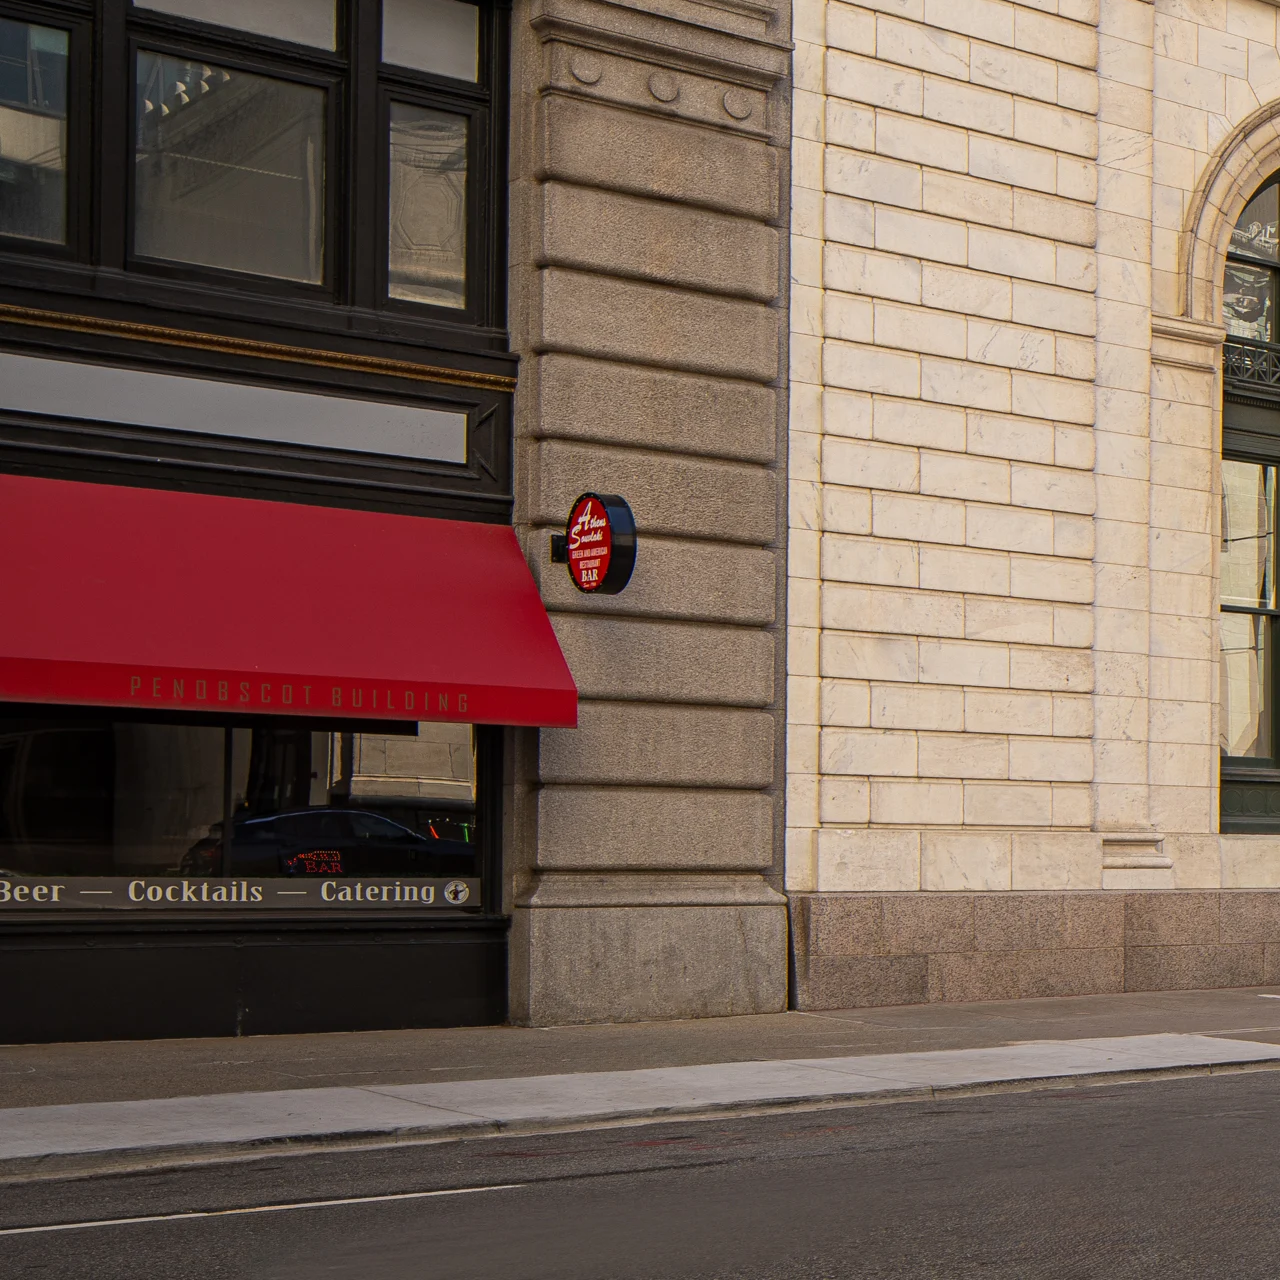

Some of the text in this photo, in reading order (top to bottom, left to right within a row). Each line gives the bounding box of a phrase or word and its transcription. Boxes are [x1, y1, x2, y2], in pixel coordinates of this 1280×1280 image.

[578, 501, 606, 531] Athens
[581, 569, 598, 582] BAR
[130, 675, 468, 713] PENOBSCOT BUILDING
[304, 860, 342, 873] BAR
[128, 880, 263, 902] Cocktails
[320, 881, 435, 903] Catering
